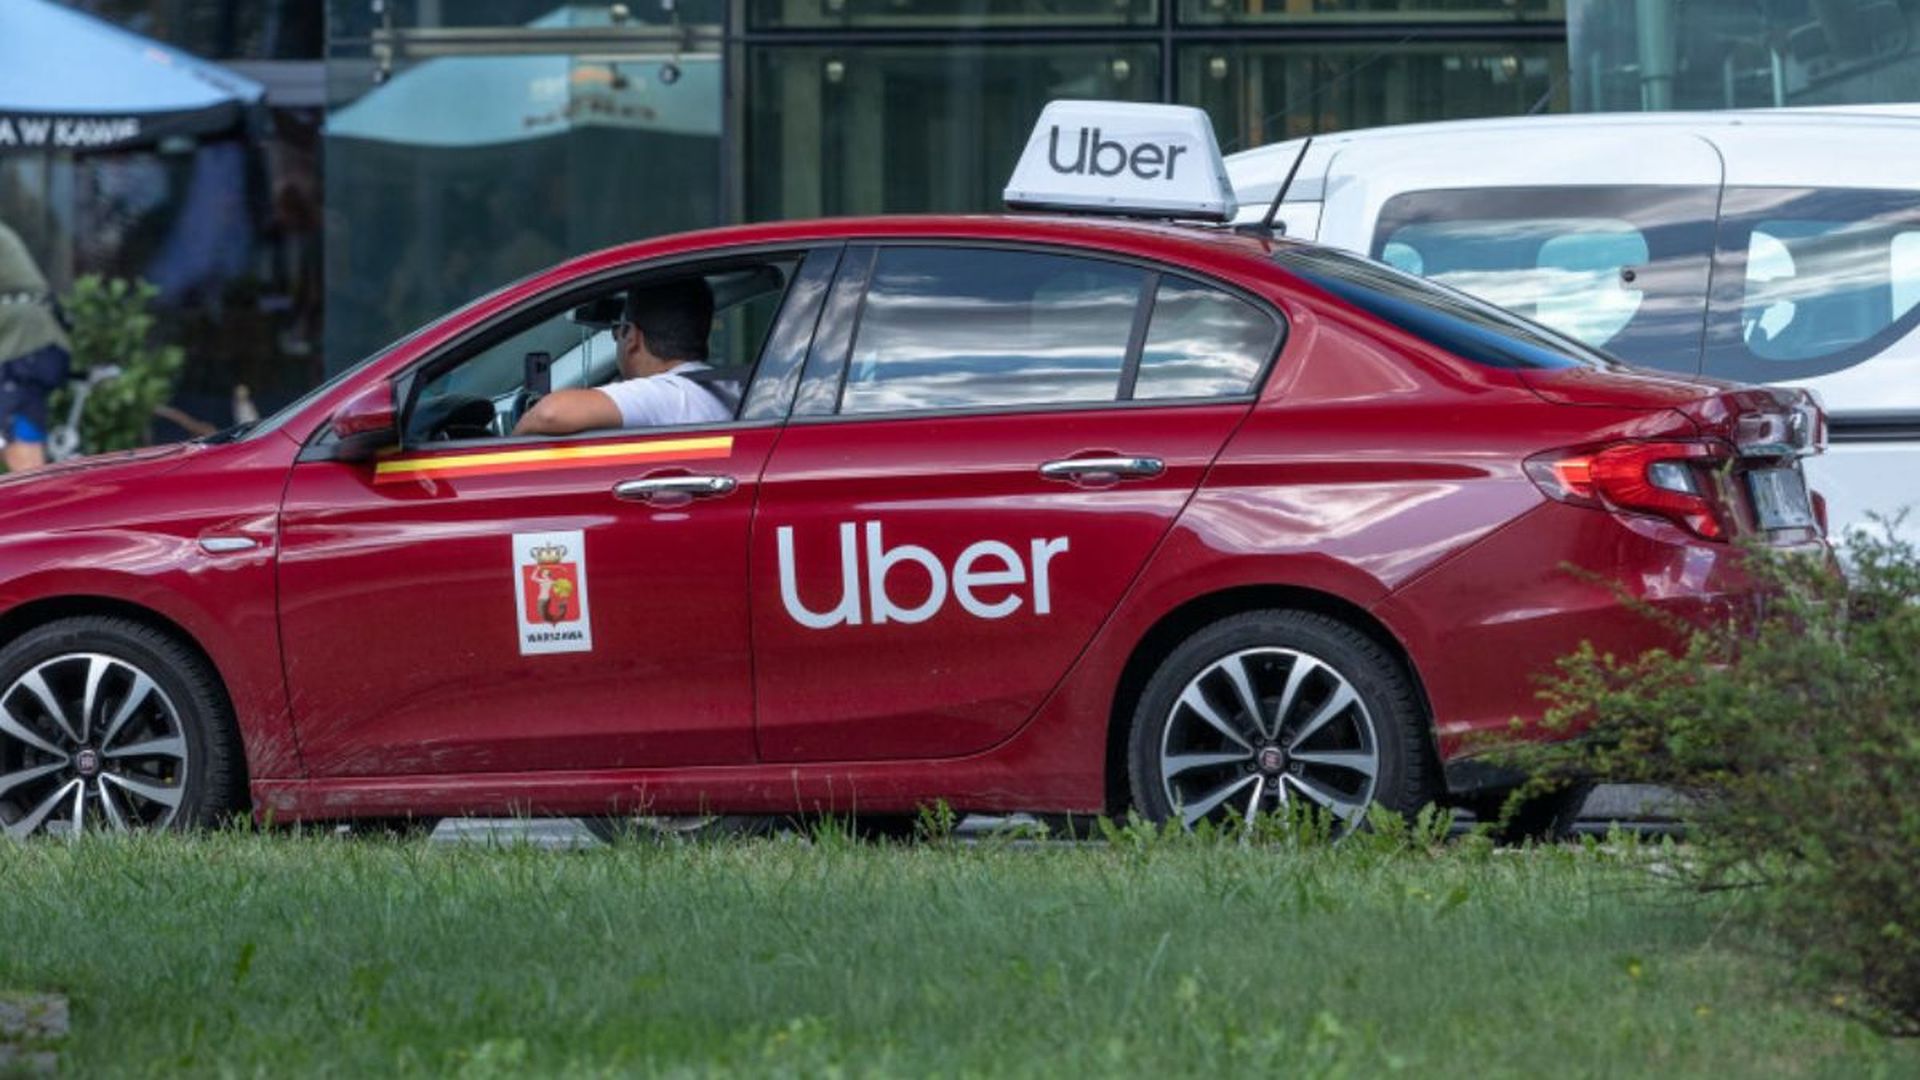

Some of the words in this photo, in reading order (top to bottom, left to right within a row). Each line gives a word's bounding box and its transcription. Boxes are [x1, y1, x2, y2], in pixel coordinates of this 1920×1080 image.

[19, 117, 50, 145] W
[1049, 125, 1187, 180] Uber
[776, 520, 1069, 629] Uber
[526, 630, 584, 642] WARSZAWA
